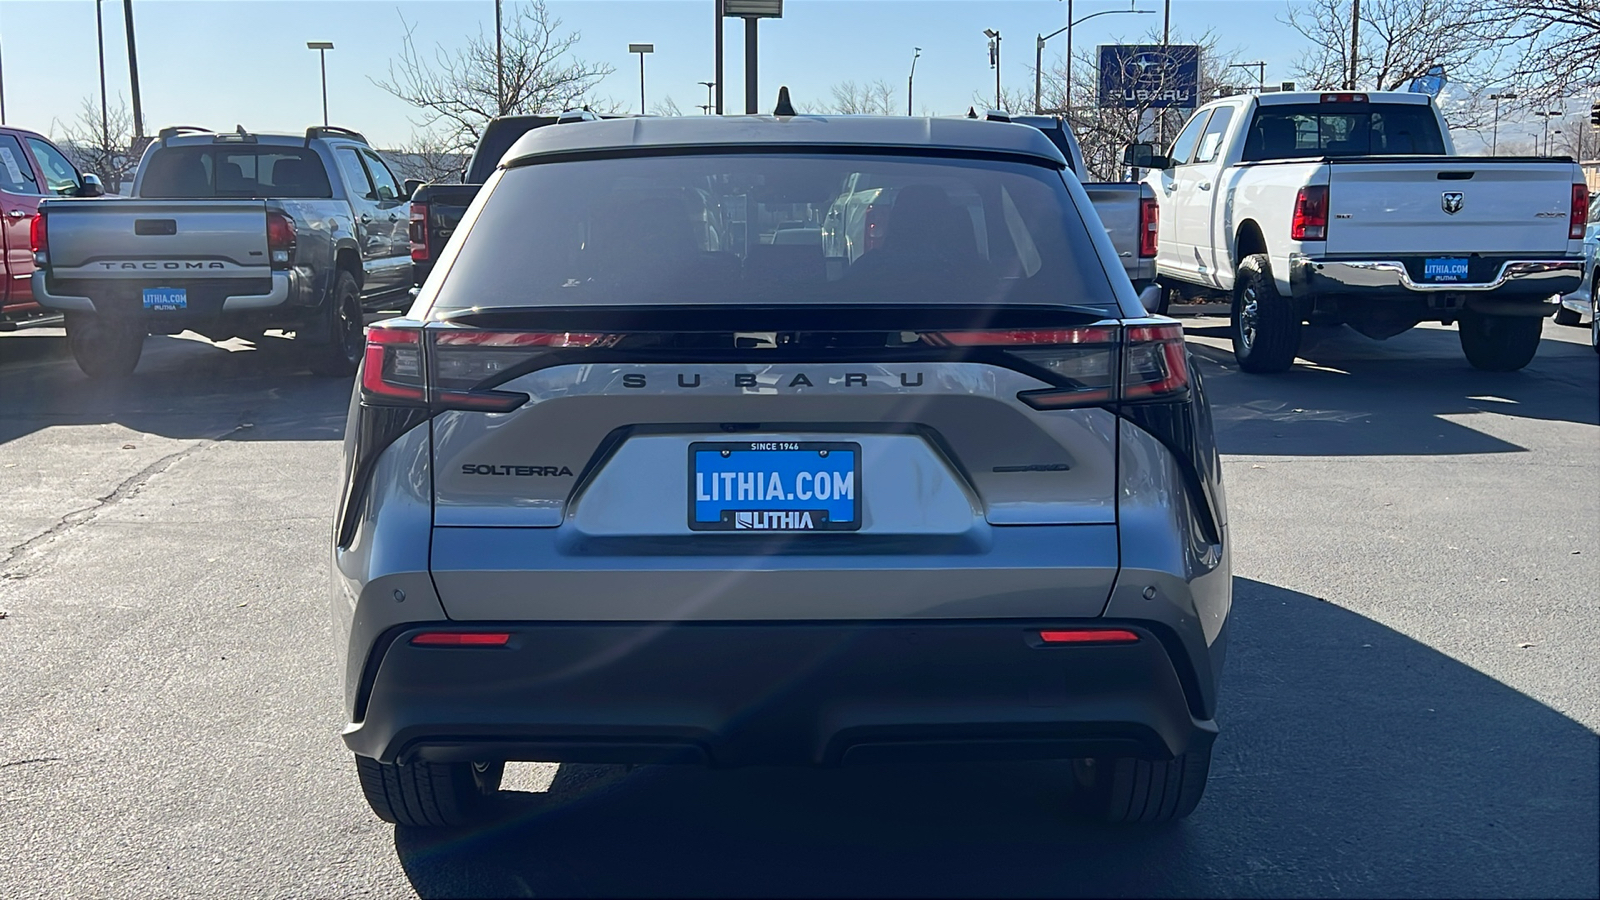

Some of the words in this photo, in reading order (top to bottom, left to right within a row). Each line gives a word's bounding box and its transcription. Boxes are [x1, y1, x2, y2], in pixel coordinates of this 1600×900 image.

[100, 262, 225, 270] TACOMA
[1424, 264, 1468, 274] LITHIA.COM
[142, 293, 187, 304] LITHIA.COM
[622, 371, 924, 389] SUBARU
[751, 442, 777, 451] SINCE
[779, 442, 799, 451] 1946
[461, 463, 574, 477] SOLTERRA
[696, 470, 855, 502] LITHIA.COM
[753, 511, 814, 529] LITHIA
